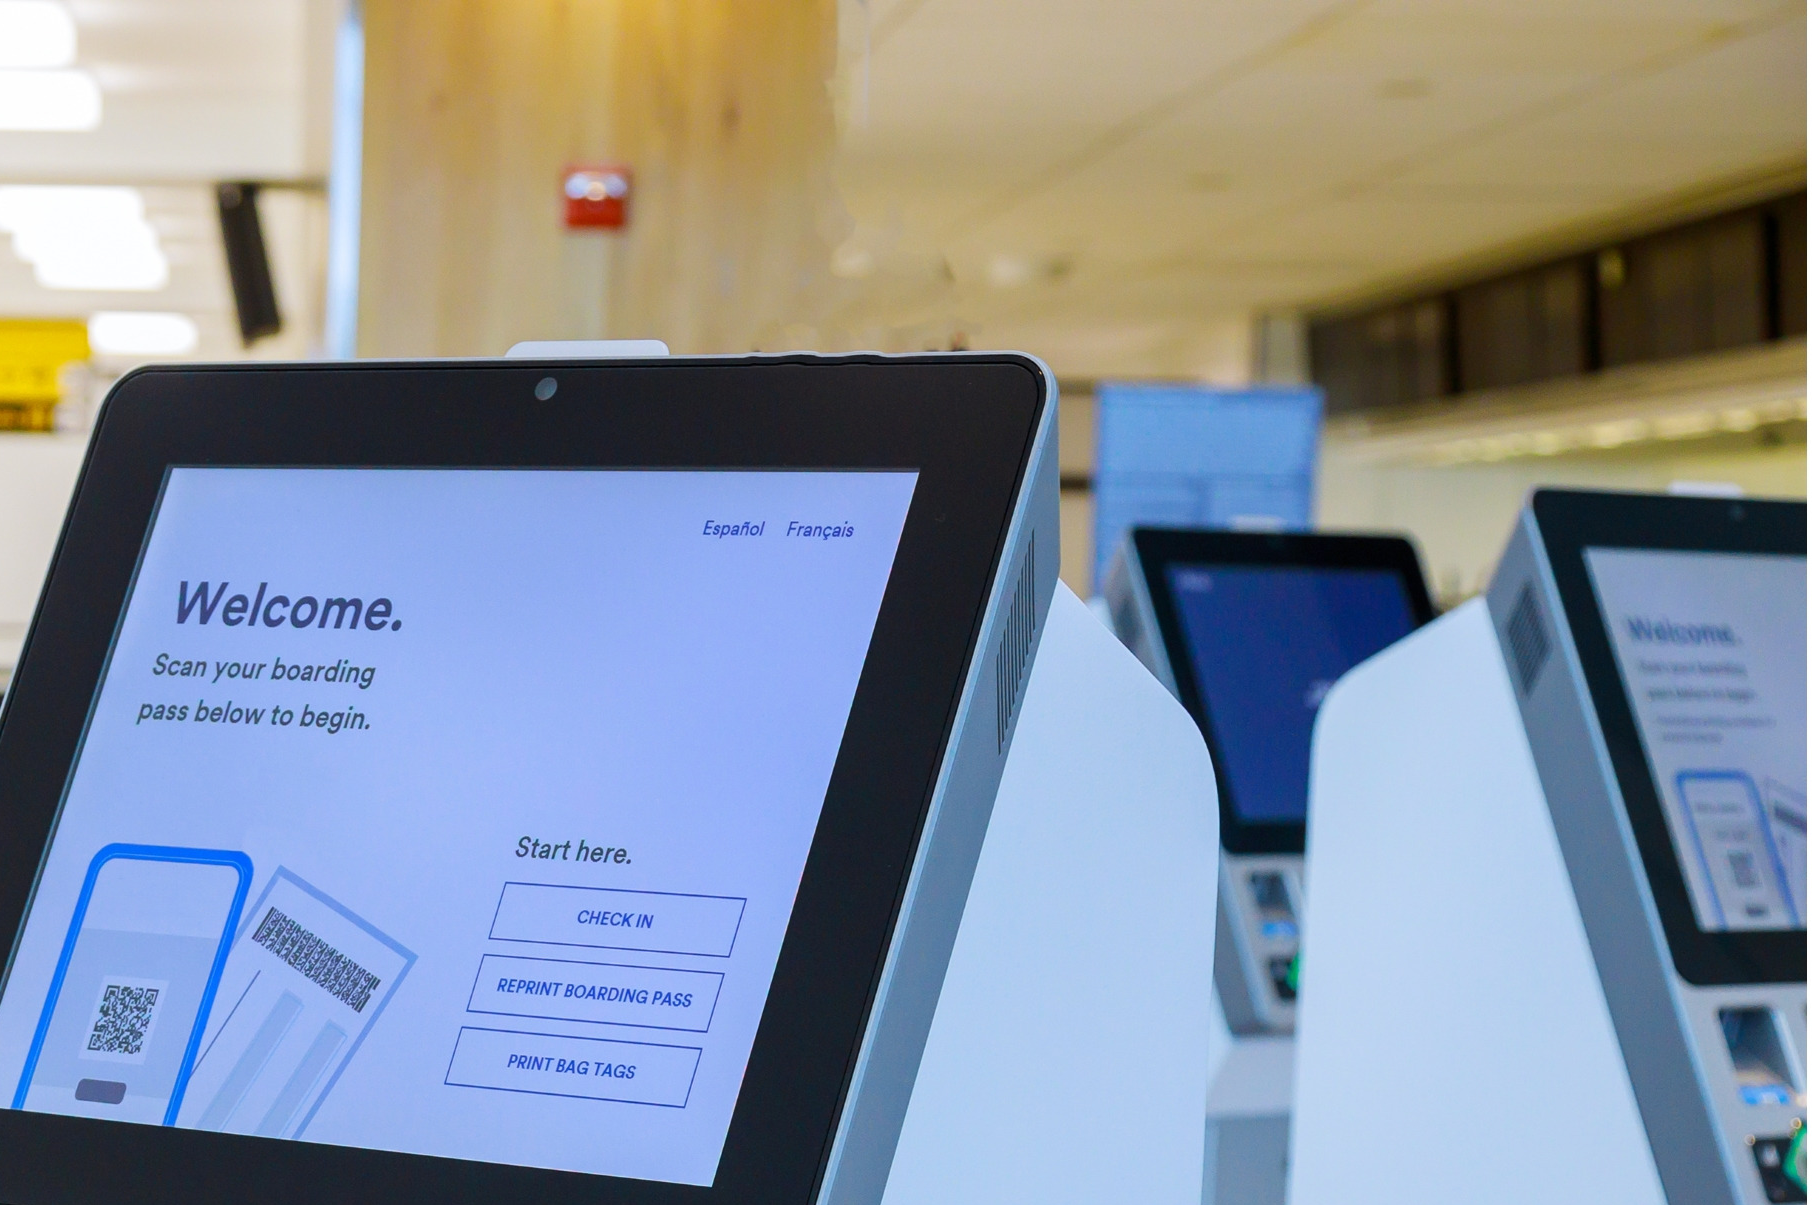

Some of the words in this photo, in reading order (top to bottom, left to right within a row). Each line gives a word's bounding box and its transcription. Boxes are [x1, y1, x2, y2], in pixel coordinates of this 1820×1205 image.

[702, 519, 766, 540] Español
[786, 520, 855, 541] Français
[176, 579, 403, 632] Welcome.
[152, 652, 208, 678] Scan
[211, 661, 268, 685] your
[270, 656, 377, 690] boarding
[135, 703, 190, 726] pass
[193, 698, 267, 725] below
[270, 704, 294, 726] to
[299, 703, 370, 735] begin.
[515, 835, 572, 861] Start
[575, 839, 632, 865] here.
[577, 909, 635, 928] CHECK
[635, 913, 655, 929] IN
[496, 977, 562, 997] REPRINT
[563, 983, 649, 1005] BOARDING
[651, 990, 694, 1008] PASS
[506, 1053, 554, 1072] PRINT
[554, 1057, 590, 1076] BAG
[592, 1061, 637, 1080] TAGS
